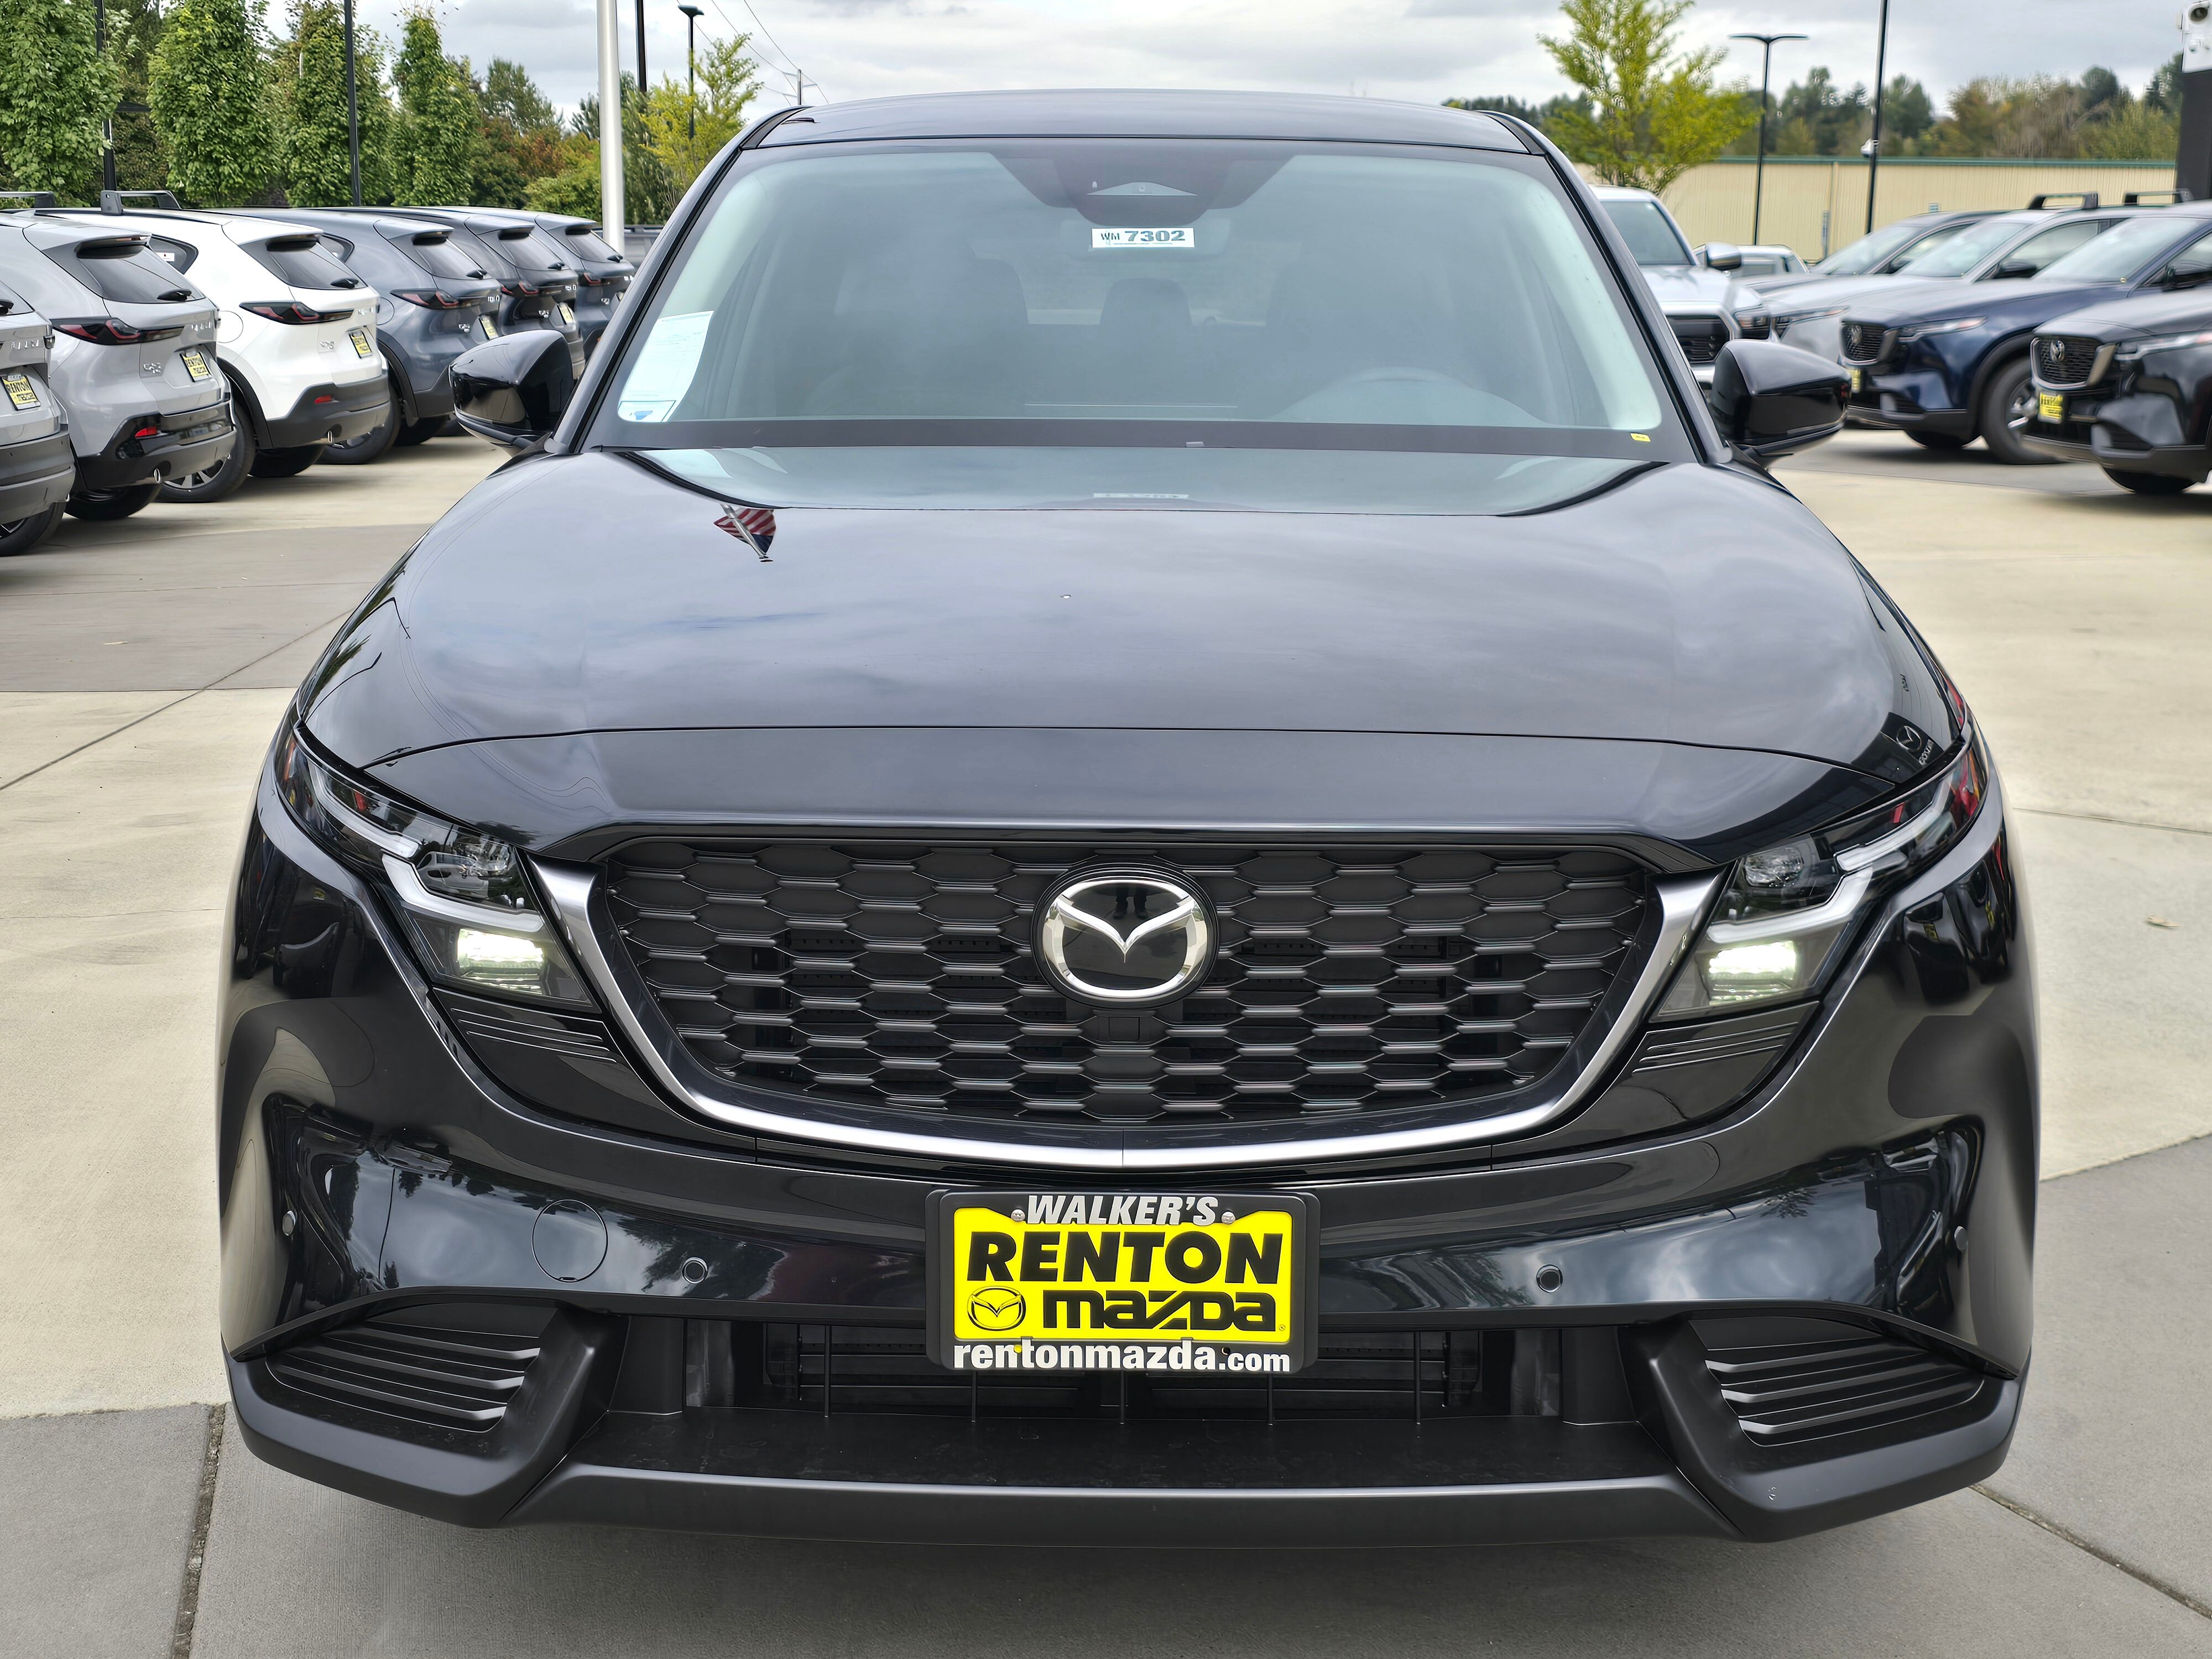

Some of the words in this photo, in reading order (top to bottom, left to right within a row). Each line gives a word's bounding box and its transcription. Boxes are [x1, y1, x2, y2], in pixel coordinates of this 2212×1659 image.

[1125, 230, 1186, 242] 7302
[1026, 1194, 1219, 1226] WALKER'S
[967, 1230, 1283, 1285] RENTON
[953, 1338, 1290, 1372] rentonmazda.com
